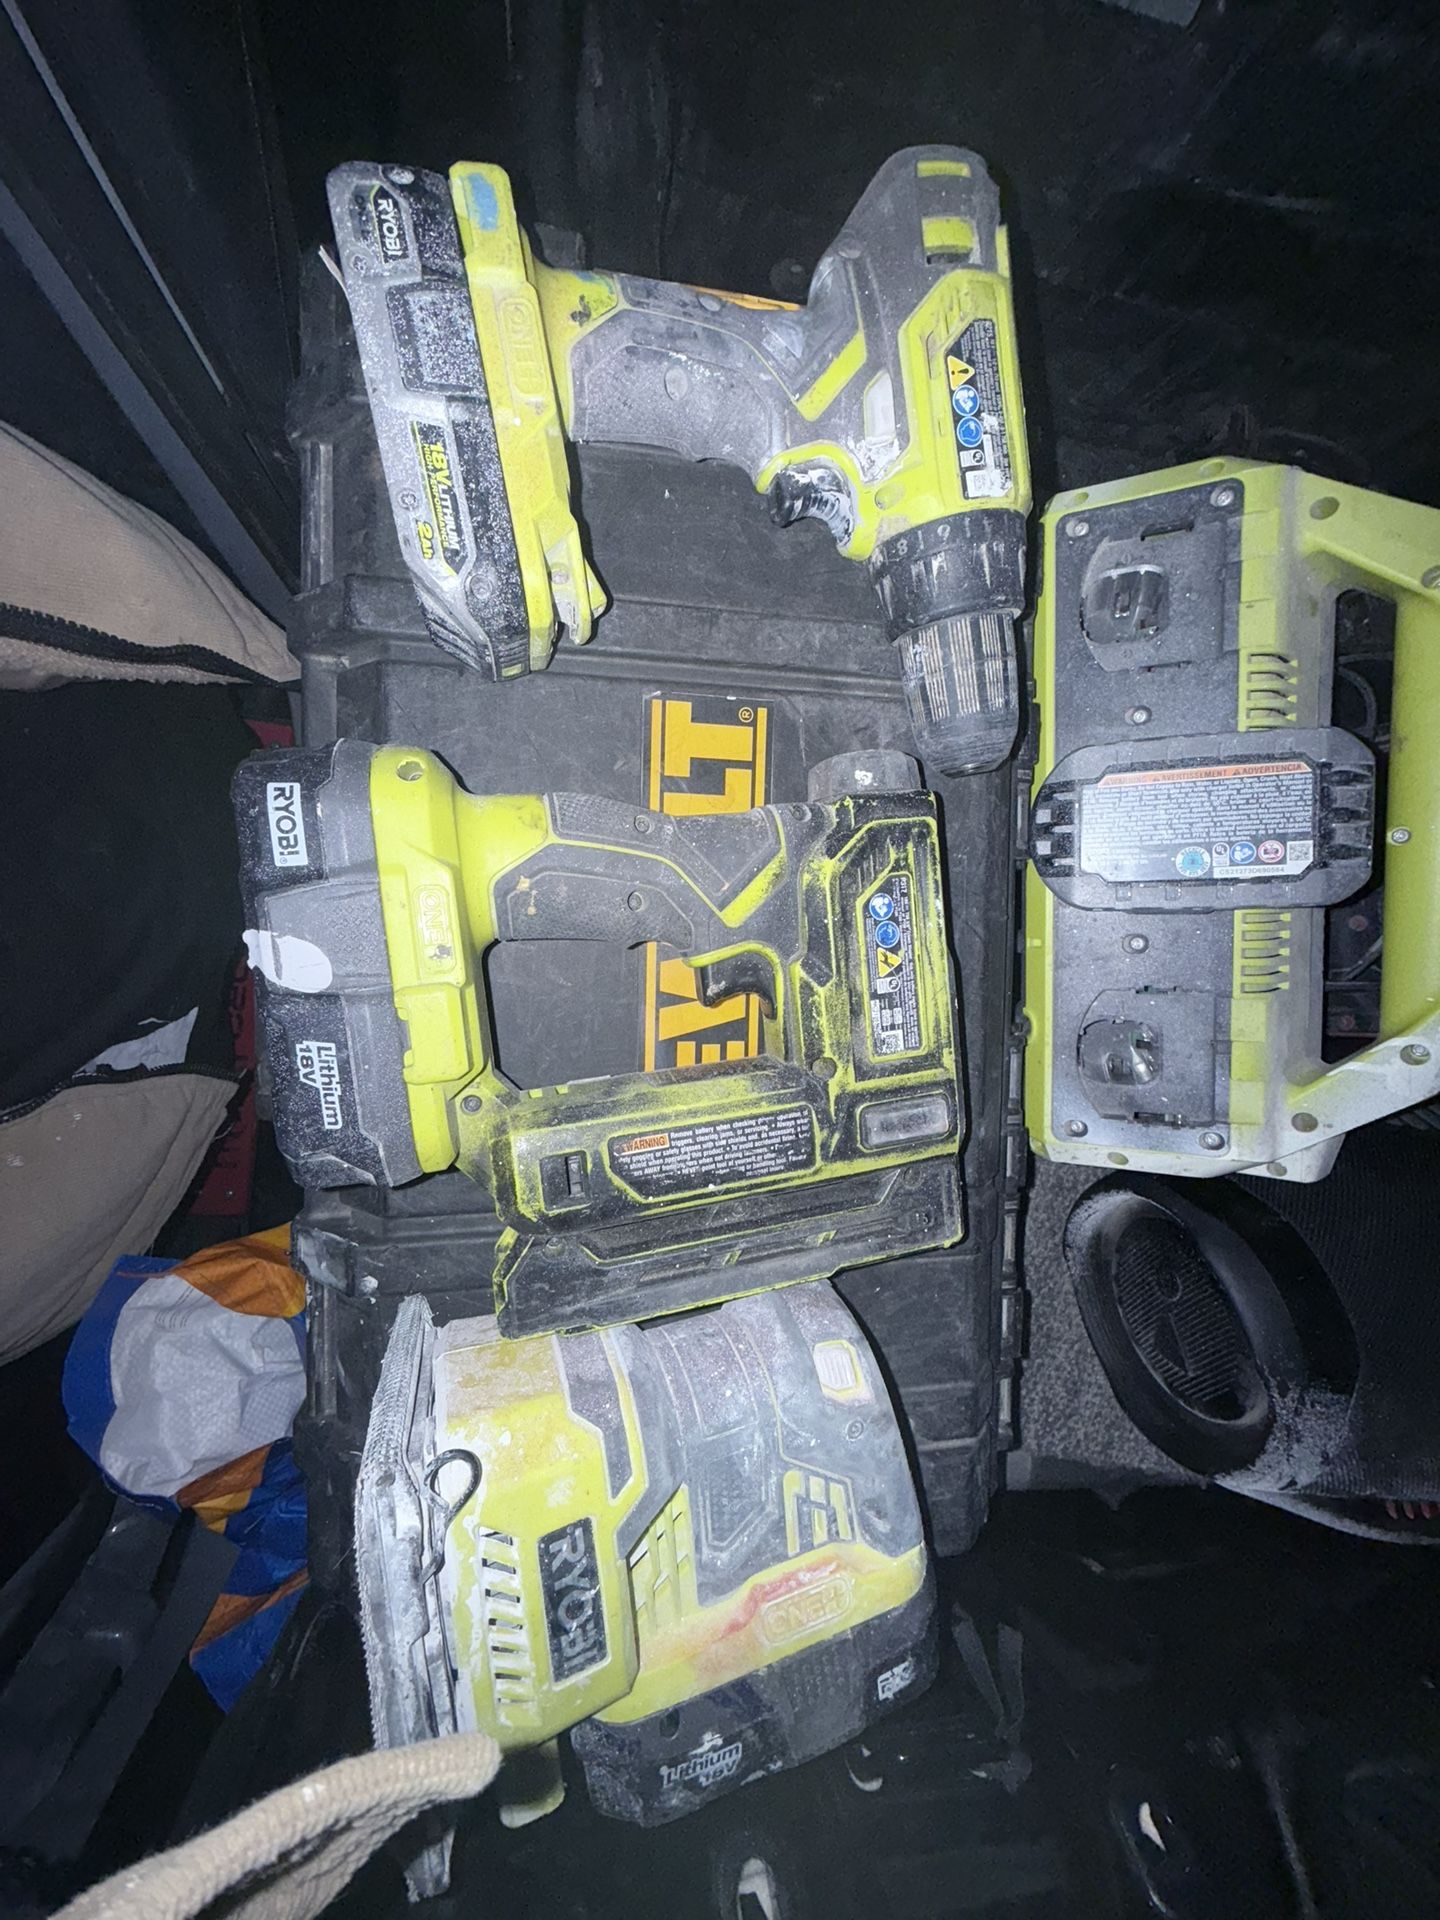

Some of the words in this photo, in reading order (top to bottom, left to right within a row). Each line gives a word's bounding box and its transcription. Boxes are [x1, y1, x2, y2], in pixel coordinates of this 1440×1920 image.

[376, 199, 402, 256] RYOBI
[421, 444, 433, 470] HIGH
[429, 442, 451, 486] 18V
[425, 472, 448, 548] PERFORMANCE
[437, 485, 459, 550] LITHIUM
[416, 521, 433, 559] 2Ah
[1161, 769, 1227, 782] AVERTISSEMENT
[1241, 763, 1303, 775] ADVERTENCIA
[271, 785, 299, 856] RYOBI
[297, 1045, 316, 1084] 18V
[316, 1046, 338, 1126] Lithium
[627, 1135, 666, 1151] WARNING
[548, 1527, 597, 1670] RYOBI
[666, 1745, 740, 1785] Lithium
